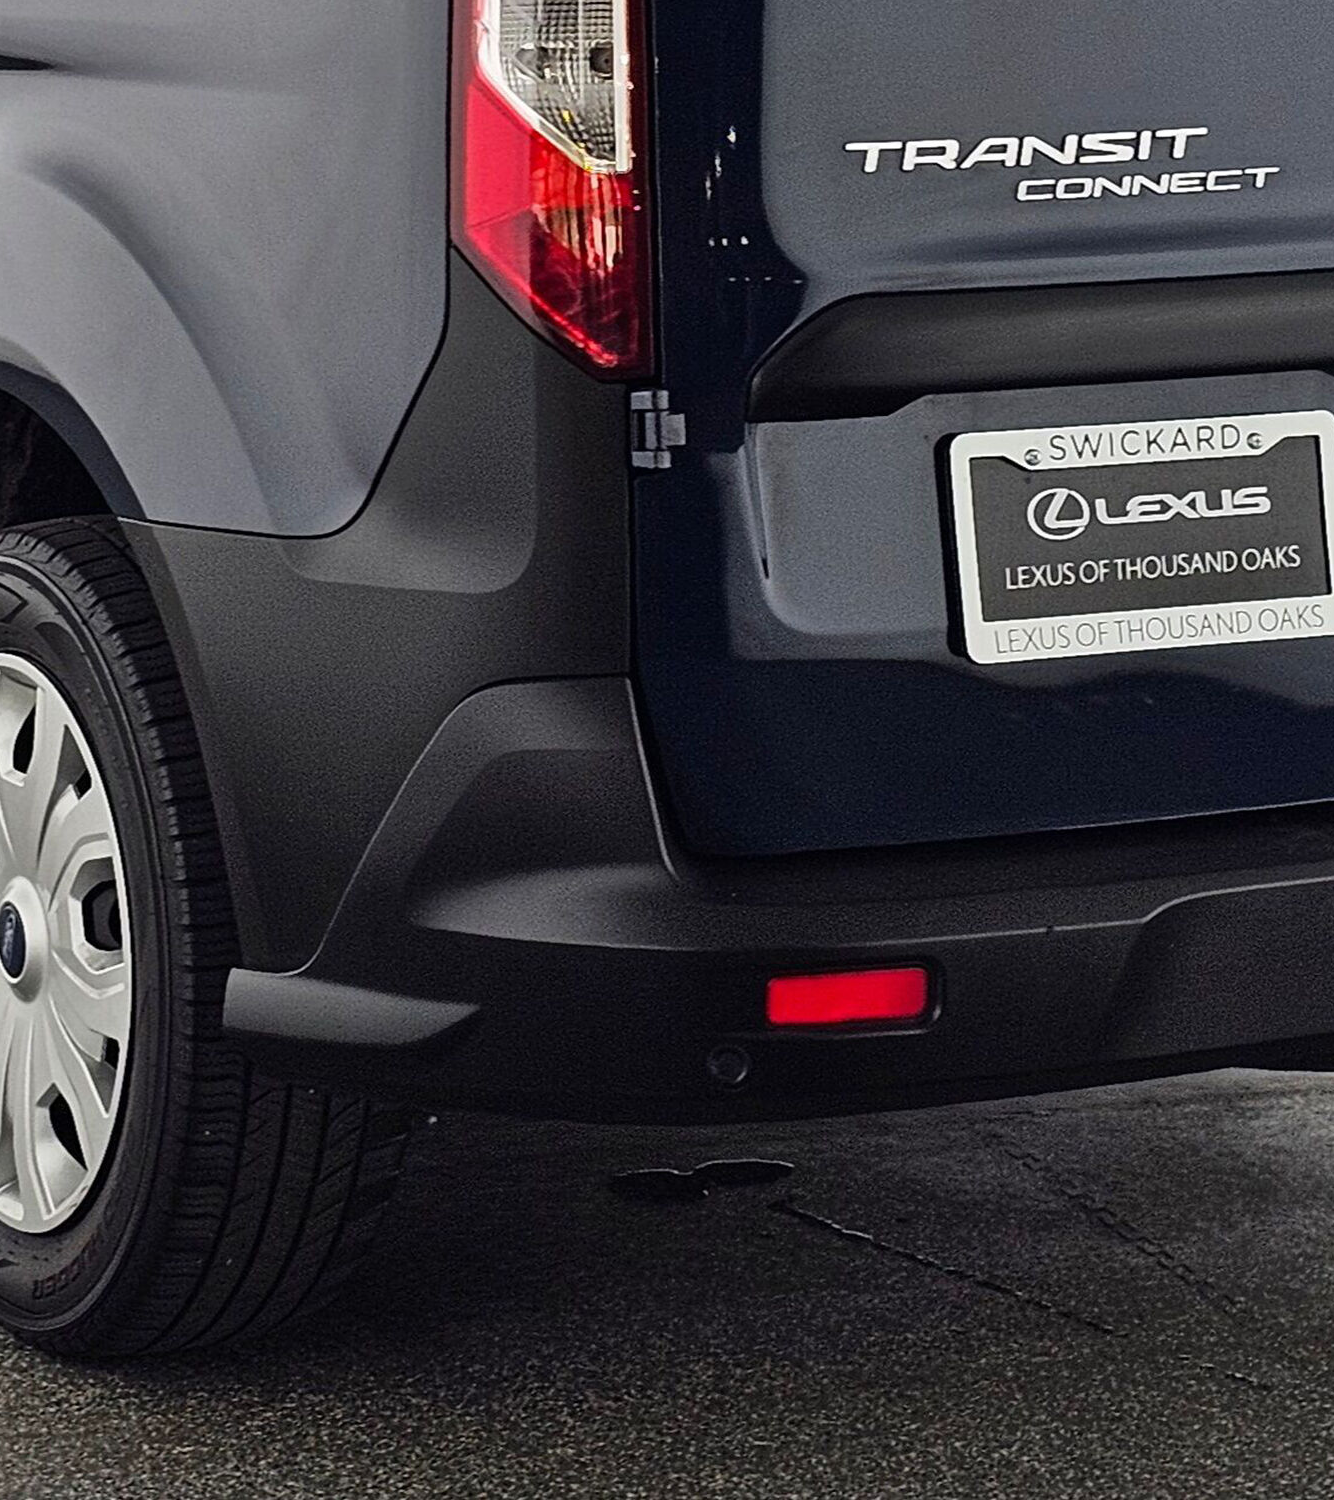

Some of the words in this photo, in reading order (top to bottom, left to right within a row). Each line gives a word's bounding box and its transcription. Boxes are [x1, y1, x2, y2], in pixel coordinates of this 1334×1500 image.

[845, 127, 1208, 173] TRANSIT
[1017, 166, 1280, 201] CONNECT
[1049, 424, 1240, 461] SWICKARD
[1095, 486, 1272, 525] LEXUS
[1005, 562, 1075, 591] LEXUS
[1079, 559, 1111, 584] OF
[1113, 550, 1239, 581] THOUSAND
[1241, 545, 1301, 570] OAKS
[994, 624, 1071, 655] LEXUS
[1076, 621, 1110, 646] OF
[1113, 611, 1253, 643] THOUSAND
[1258, 604, 1325, 633] OAKS
